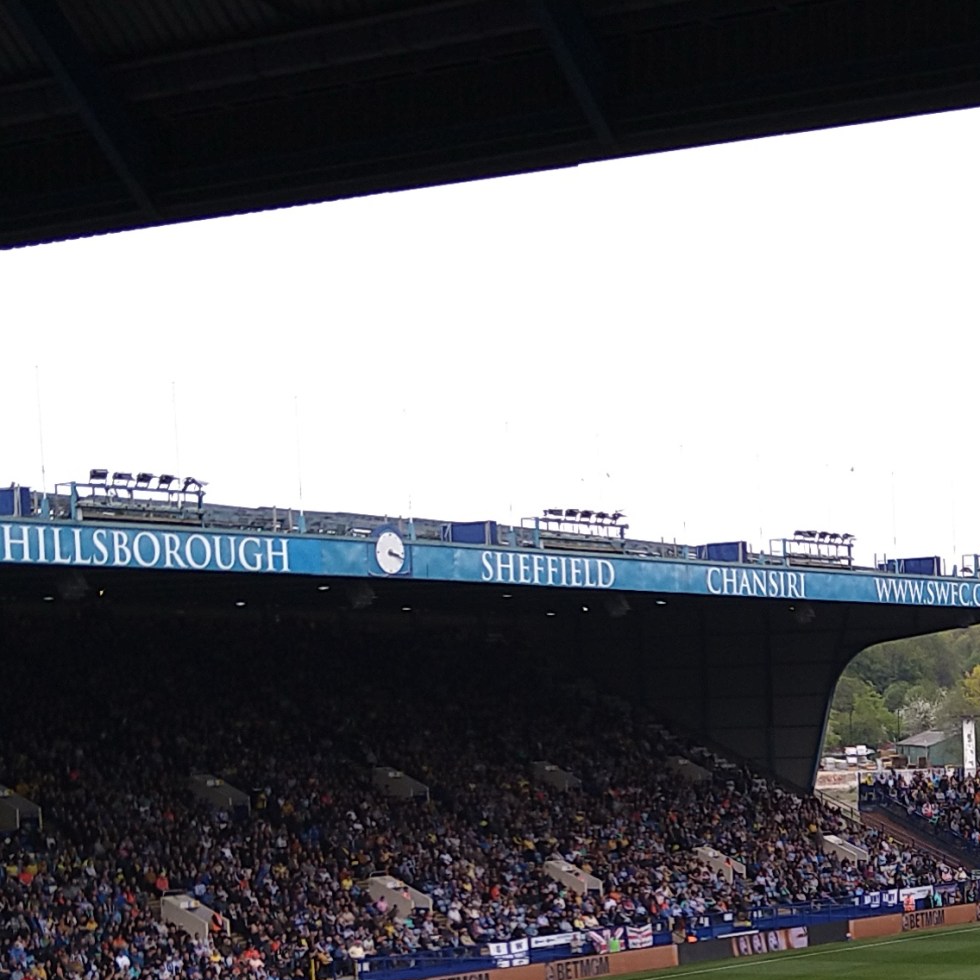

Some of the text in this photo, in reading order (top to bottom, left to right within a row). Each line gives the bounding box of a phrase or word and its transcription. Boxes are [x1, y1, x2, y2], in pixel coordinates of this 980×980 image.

[3, 525, 291, 572] HILLSBOROUGH
[481, 551, 615, 590] SHEFFIELD
[707, 567, 806, 599] CHANSIRI
[556, 957, 610, 980] BETMGM
